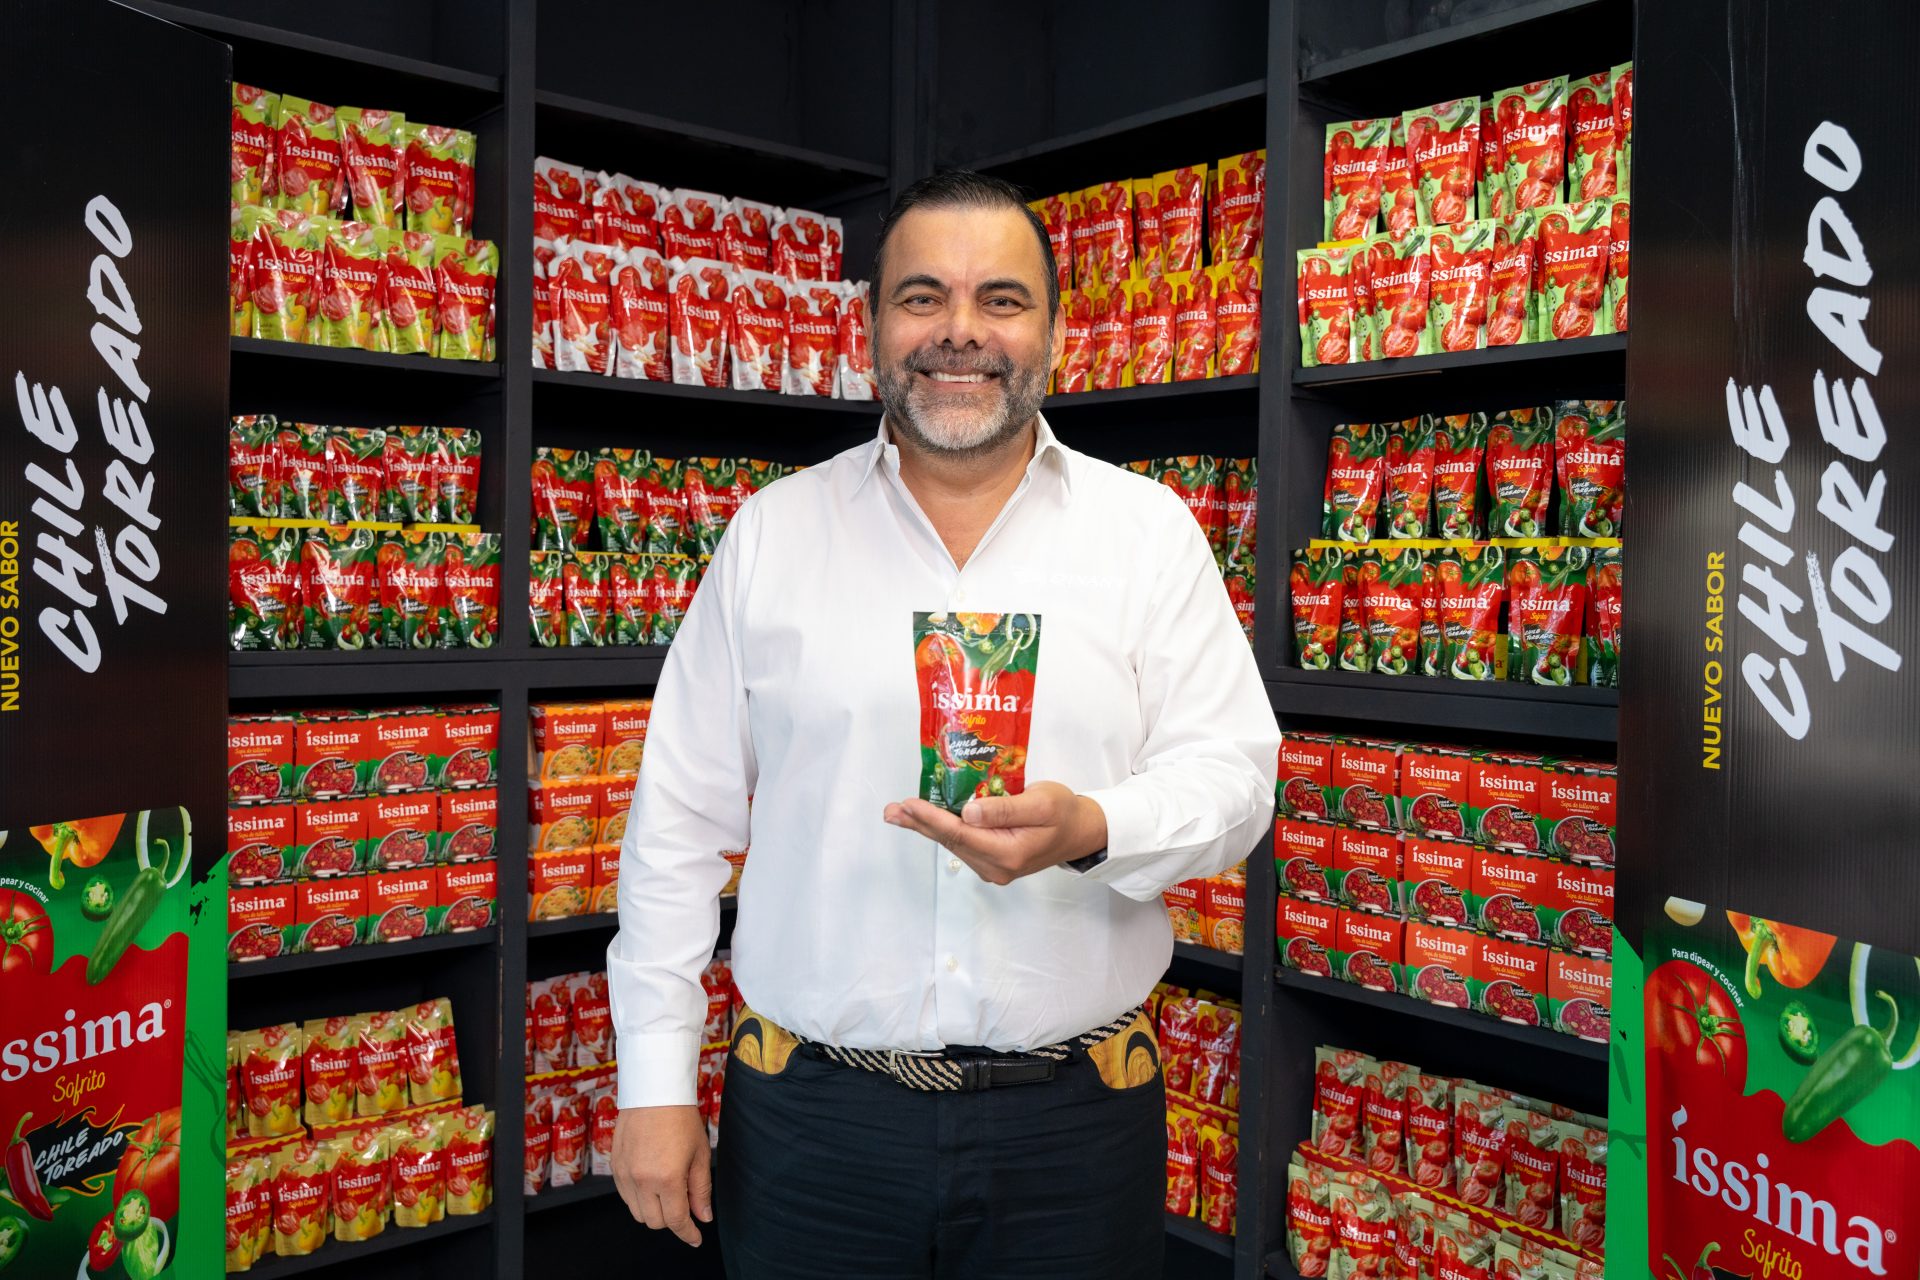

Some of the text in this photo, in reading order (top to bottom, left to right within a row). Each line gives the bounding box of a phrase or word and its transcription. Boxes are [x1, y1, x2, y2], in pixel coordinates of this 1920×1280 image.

[1574, 114, 1614, 135] ssim
[1332, 158, 1378, 176] ssima
[1224, 191, 1263, 208] ssima
[1162, 207, 1199, 221] ssima
[1493, 252, 1527, 273] ssima
[1544, 245, 1598, 264] ssima
[1431, 260, 1484, 282] ssima
[1176, 308, 1208, 322] ssima
[1217, 301, 1258, 316] ssima
[1133, 313, 1168, 329] ssima
[85, 195, 168, 625] TOREADO
[1803, 120, 1902, 682] TOREADO
[230, 451, 273, 467] ssima
[1566, 448, 1622, 466] ssima
[1331, 466, 1377, 481] ssima
[1390, 461, 1424, 477] ssima
[1434, 460, 1476, 476] ssima
[15, 370, 101, 673] CHILE
[1726, 377, 1811, 740] CHILE
[1363, 592, 1413, 609] ssima
[1441, 594, 1489, 609] ssima
[1520, 593, 1571, 612] ssima
[1, 521, 20, 712] NUEVO SABOR
[1702, 551, 1726, 770] NUEVO SABOR
[445, 722, 493, 738] íssima
[554, 720, 597, 735] íssima
[612, 716, 648, 730] íssim
[958, 713, 987, 728] Sofrito
[306, 729, 360, 746] íssima
[377, 724, 429, 741] íssima
[950, 738, 978, 750] CHILE
[954, 746, 996, 757] TOREADO
[1281, 746, 1323, 767] íssima
[1341, 752, 1387, 775] íssima
[1409, 760, 1460, 783] íssima
[1480, 770, 1536, 793] íssima
[550, 792, 592, 807] íssima
[607, 787, 633, 801] íssi
[1552, 780, 1611, 804] íssima
[305, 809, 359, 826] íssima
[378, 803, 430, 819] íssima
[1282, 826, 1326, 848] íssima
[1342, 835, 1389, 858] íssima
[602, 856, 619, 871] íss
[1412, 845, 1463, 870] íssima
[446, 871, 494, 888] íssima
[542, 863, 585, 878] íssima
[1481, 859, 1536, 884] íssima
[0, 877, 18, 887] pear
[24, 882, 49, 904] cocinar
[377, 879, 429, 896] íssima
[1164, 885, 1197, 899] ssima
[1557, 871, 1614, 898] íssima
[230, 896, 286, 914] íssima
[307, 887, 360, 905] íssima
[1211, 888, 1245, 908] íssim
[1284, 904, 1328, 928] íssima
[1345, 917, 1392, 942] íssima
[1415, 930, 1467, 956] íssima
[1482, 944, 1536, 972] íssima
[1559, 961, 1612, 988] íssima
[1671, 947, 1745, 1008] Para dipear y cocinar
[1, 998, 171, 1082] ssima®
[53, 1069, 105, 1102] Sofrito
[1320, 1085, 1355, 1105] ssima
[1366, 1102, 1402, 1121] ssima
[1409, 1114, 1445, 1131] ssima
[34, 1127, 88, 1170] CHILE
[1462, 1127, 1501, 1152] ssima
[44, 1131, 124, 1185] TOREADO
[1292, 1206, 1331, 1226] ssima
[1340, 1223, 1380, 1244] ssima
[1741, 1229, 1802, 1280] Sofrito
